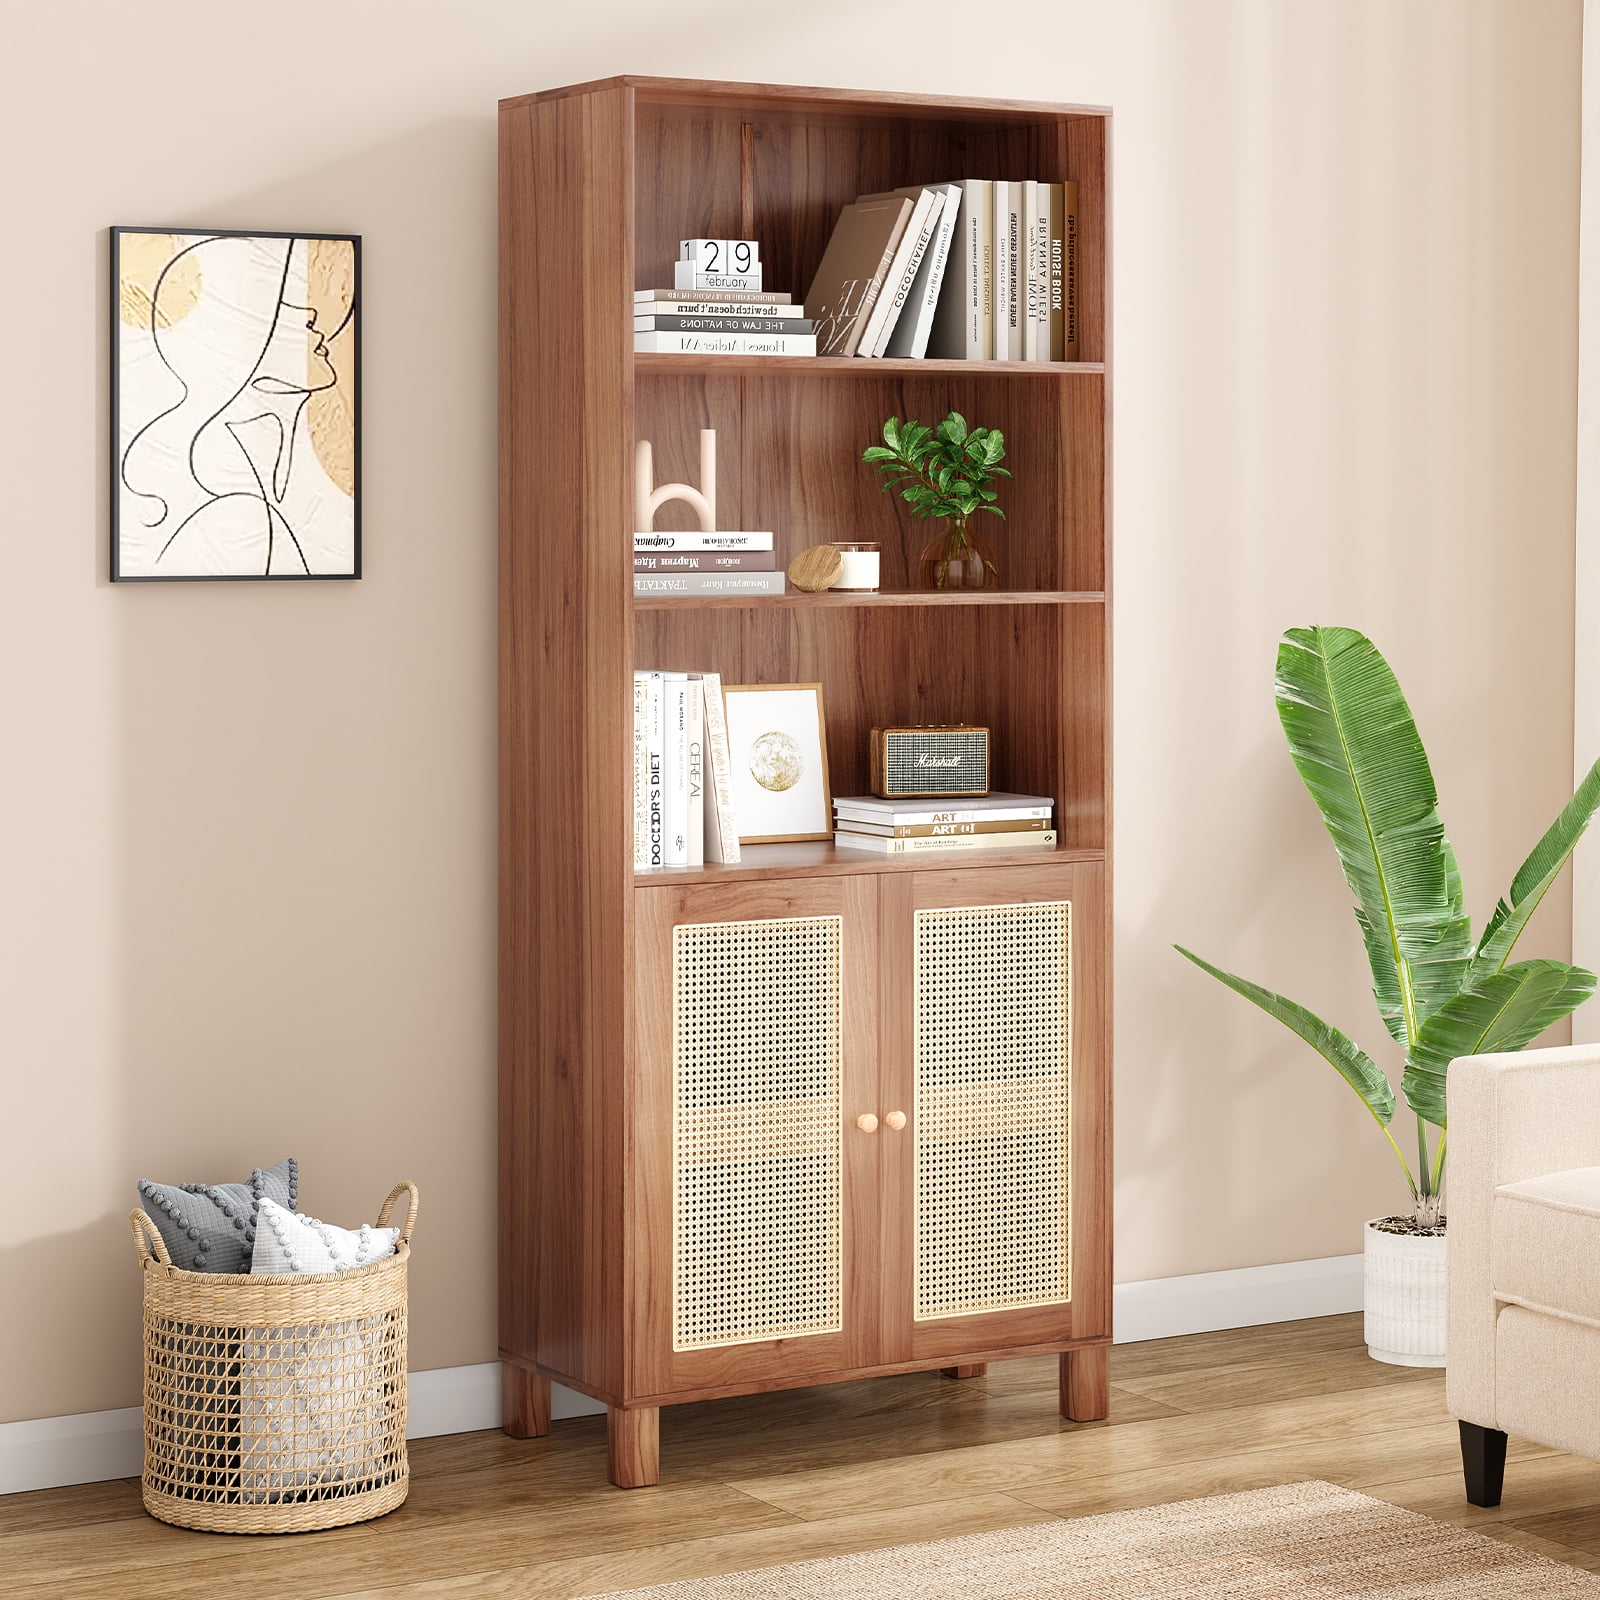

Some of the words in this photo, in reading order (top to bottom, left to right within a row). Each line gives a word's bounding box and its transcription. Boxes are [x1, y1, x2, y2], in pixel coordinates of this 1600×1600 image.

[706, 275, 747, 288] february
[661, 556, 699, 568] Мартин
[914, 753, 960, 767] Marshall
[650, 752, 660, 785] DIET
[690, 742, 701, 804] CEREAL
[932, 813, 957, 823] ART
[931, 825, 957, 835] ART
